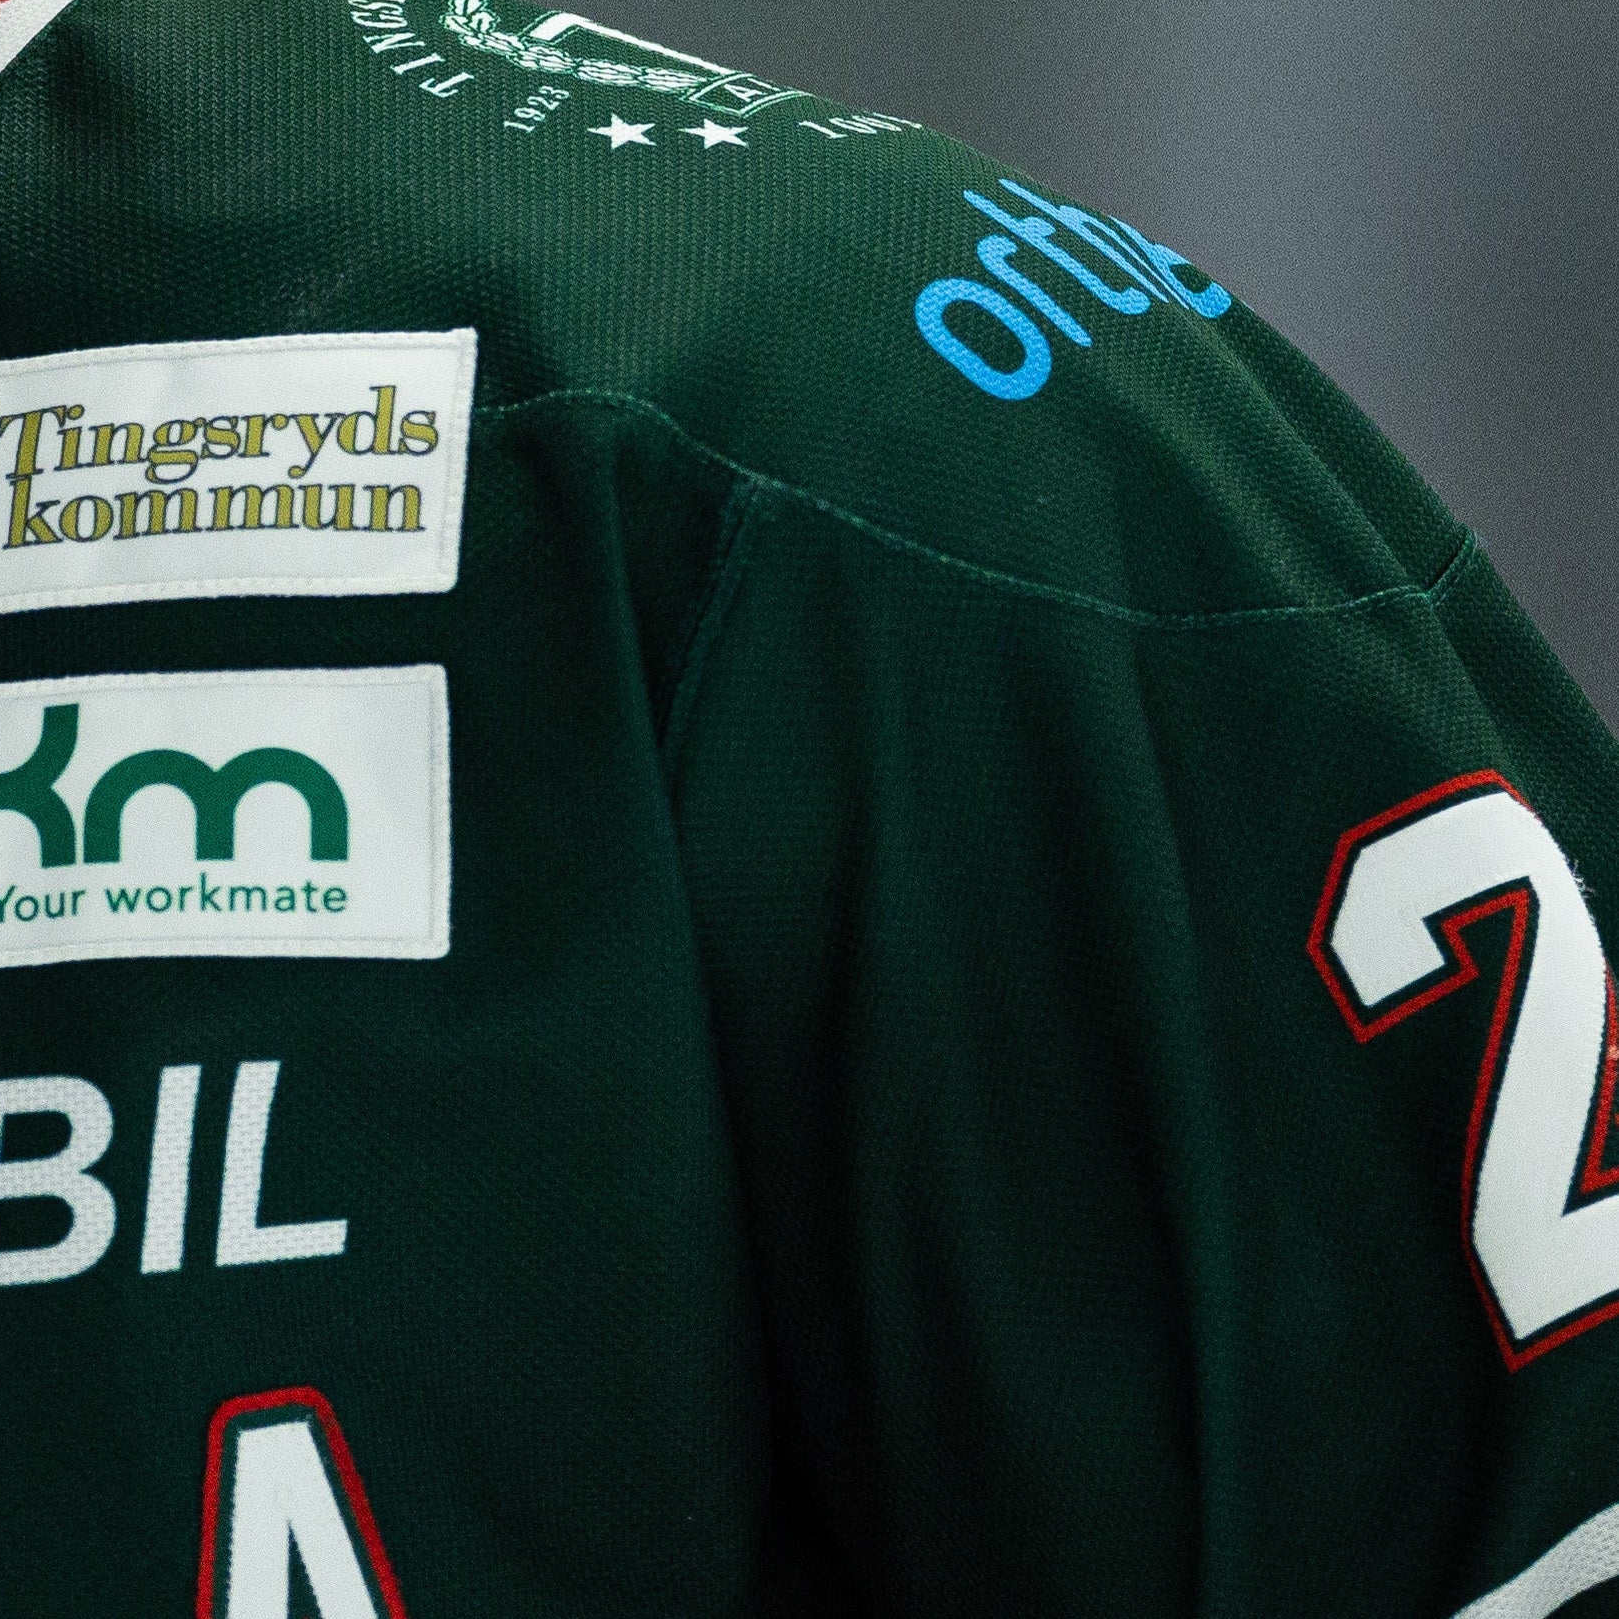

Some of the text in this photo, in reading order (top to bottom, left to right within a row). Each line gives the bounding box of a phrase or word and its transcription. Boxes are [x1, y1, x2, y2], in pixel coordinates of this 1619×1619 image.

[503, 84, 571, 134] 1923
[3, 473, 427, 550] kommun
[104, 872, 349, 914] workmate
